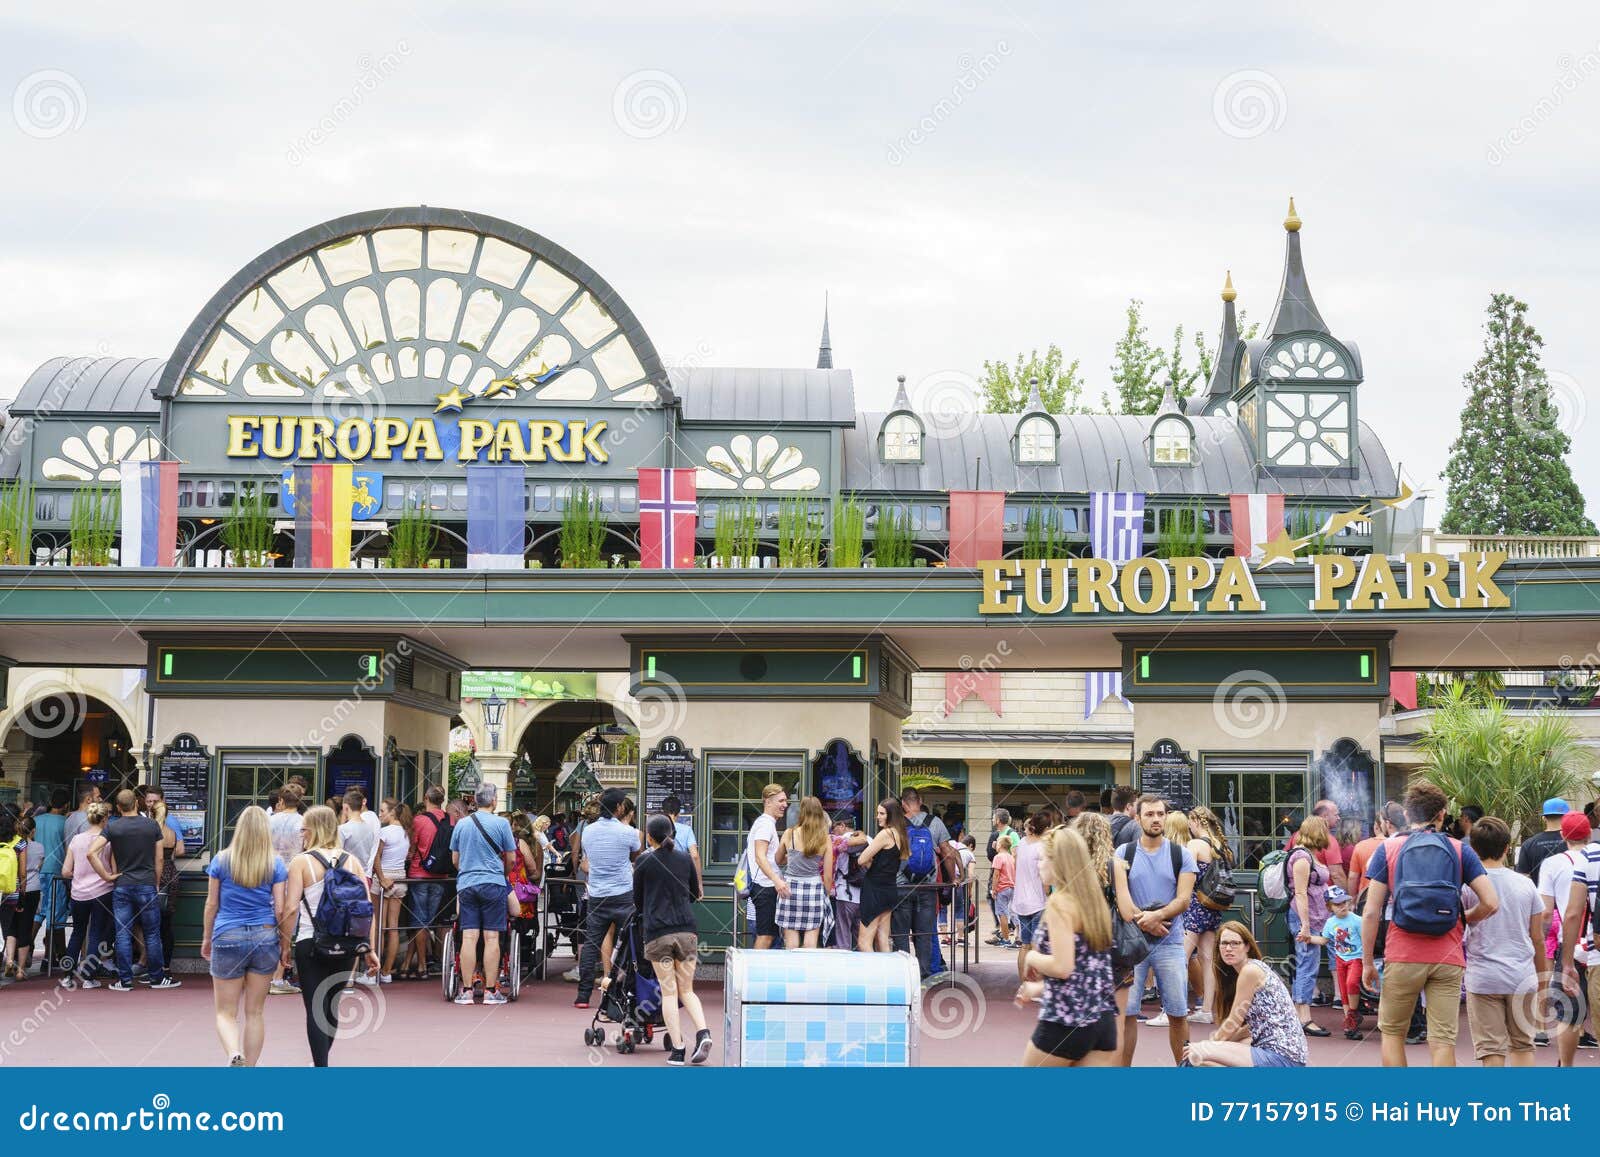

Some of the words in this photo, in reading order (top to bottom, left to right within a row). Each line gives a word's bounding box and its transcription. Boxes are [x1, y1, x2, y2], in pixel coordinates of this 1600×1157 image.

[226, 414, 444, 461] EUROPA
[457, 418, 609, 463] PARK
[977, 556, 1267, 614] EUROPA
[1308, 551, 1511, 611] PARK
[180, 739, 190, 748] 11
[665, 742, 677, 751] 13
[1159, 745, 1172, 754] 15
[1017, 765, 1086, 776] Information
